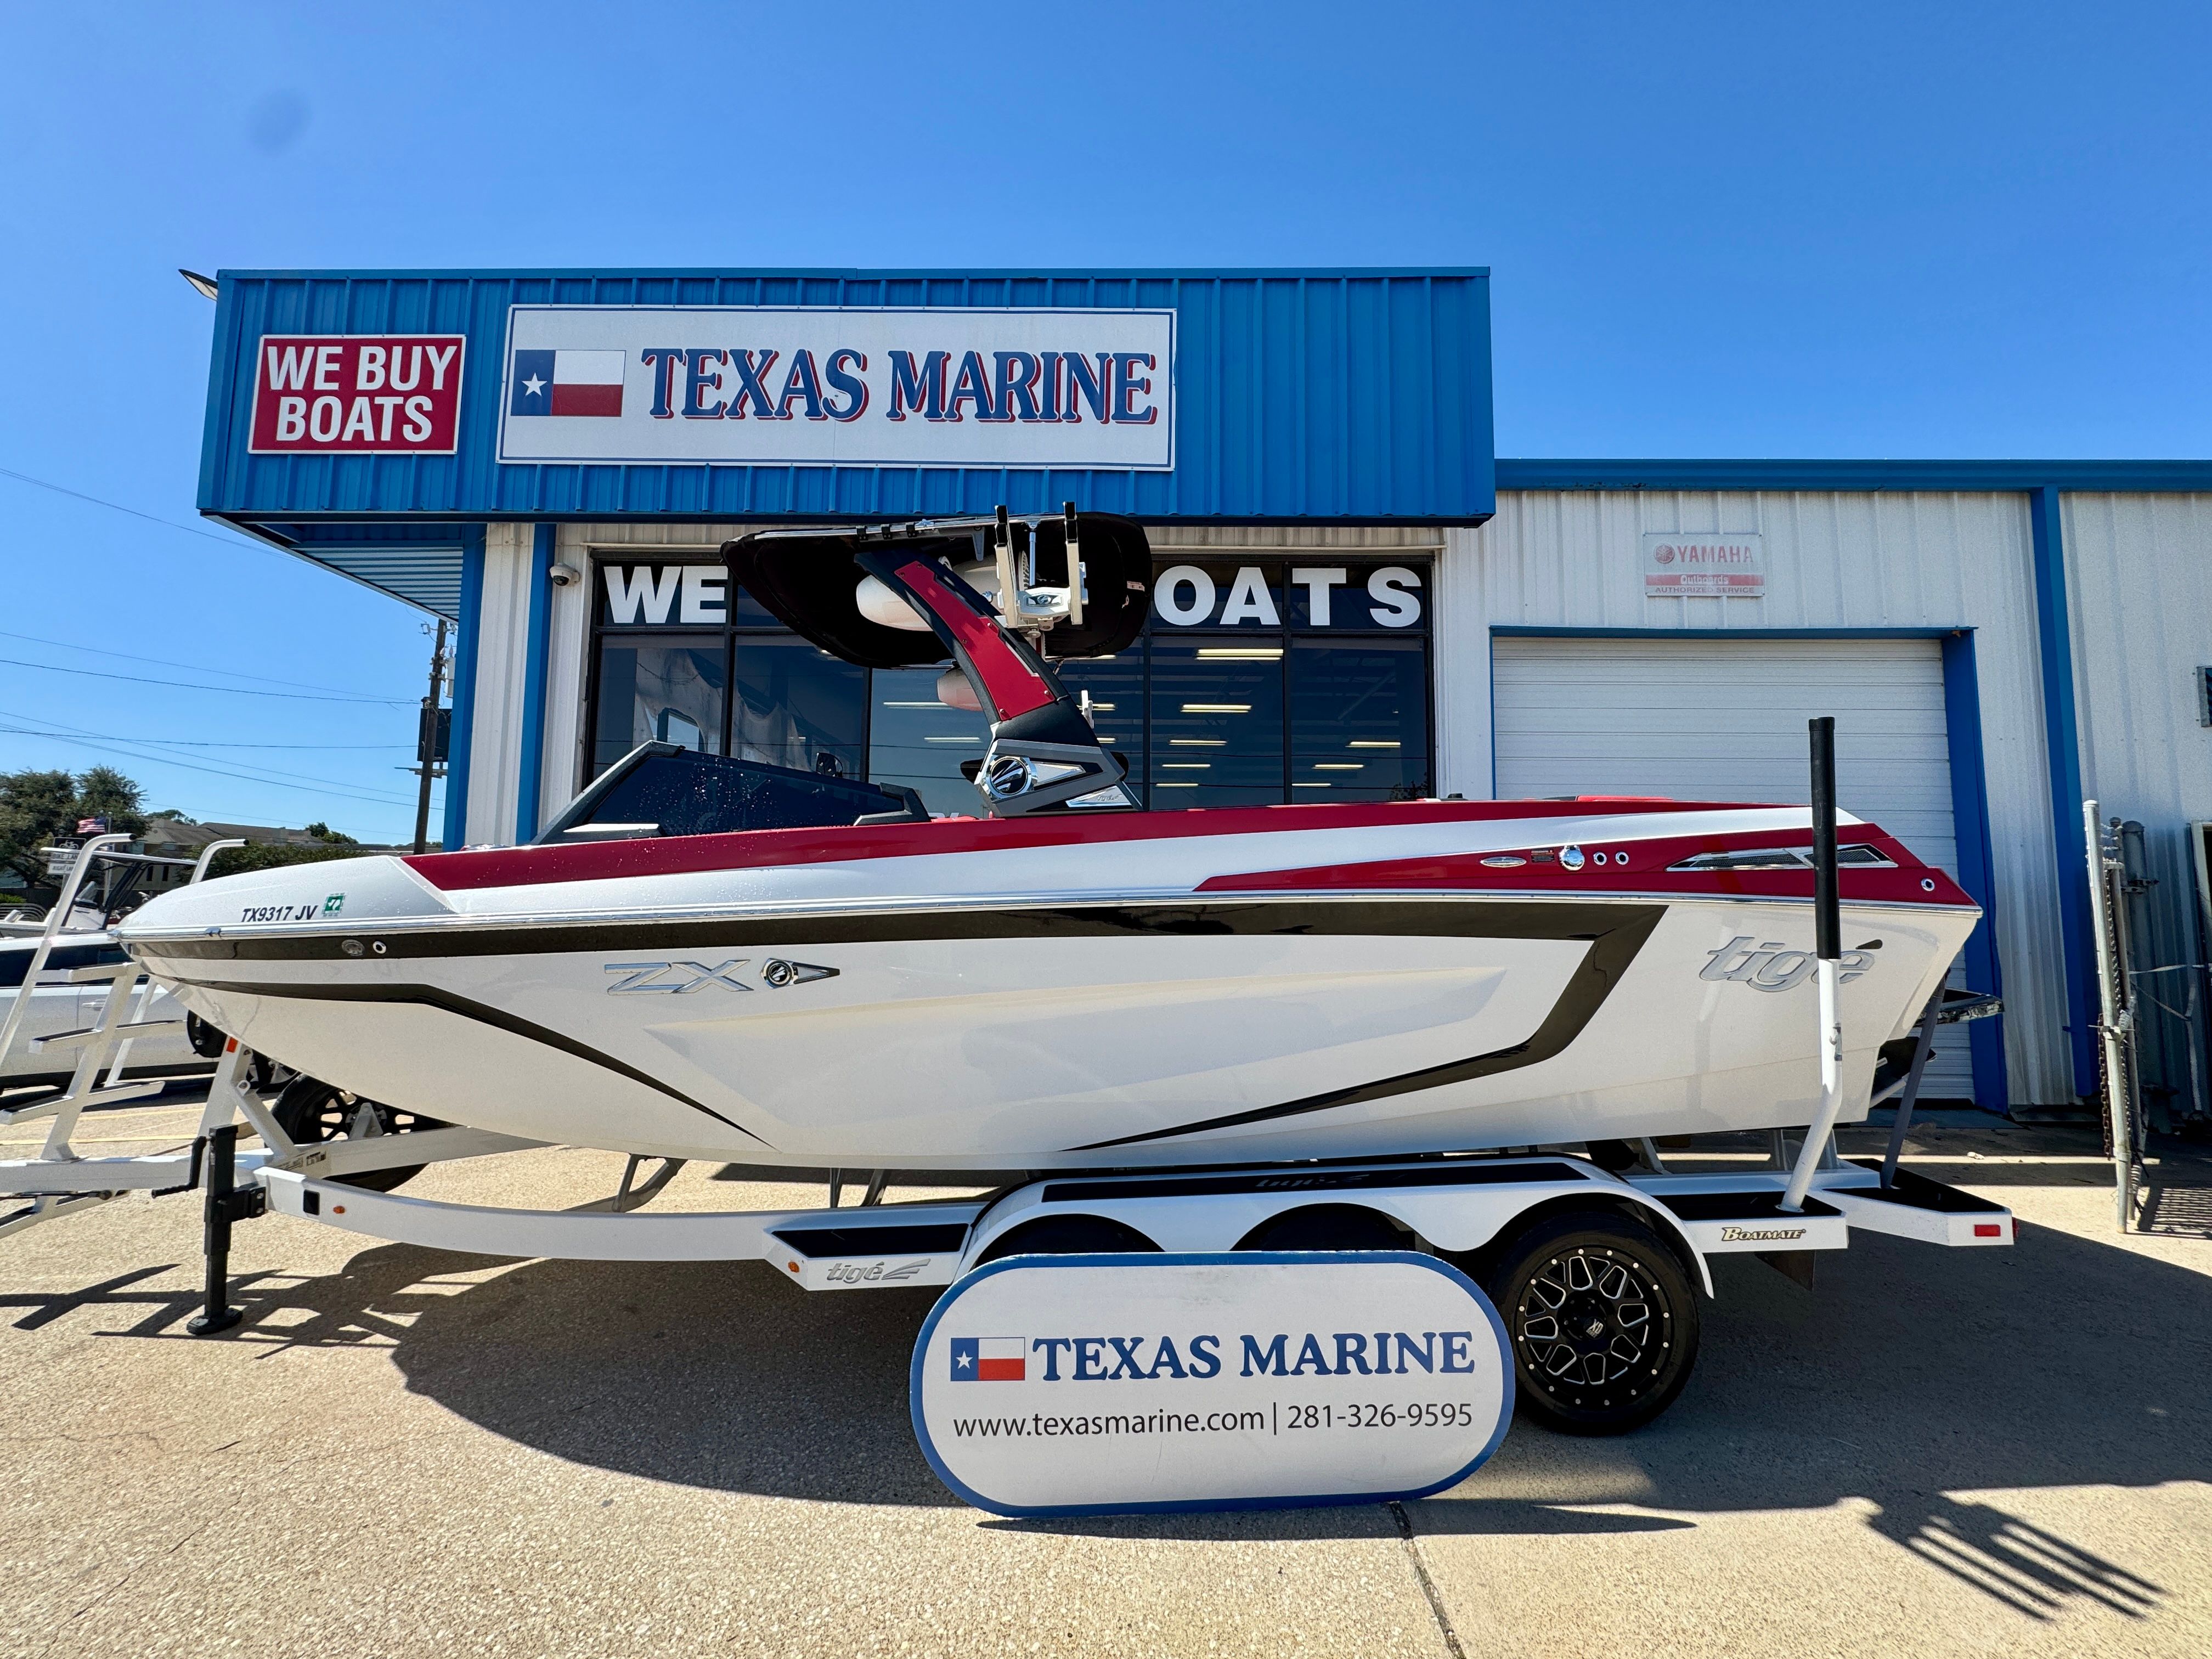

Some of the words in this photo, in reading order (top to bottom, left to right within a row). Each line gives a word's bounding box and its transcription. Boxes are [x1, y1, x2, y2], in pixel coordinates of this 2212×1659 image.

[267, 345, 344, 391] WE
[356, 345, 458, 391] BUY
[641, 348, 869, 423] TEXAS
[886, 350, 1158, 425] MARINE
[275, 396, 433, 442] BOATS
[1677, 545, 1754, 563] YAMAHA
[603, 566, 729, 623] WE
[1154, 565, 1422, 628] OATS
[1680, 574, 1729, 585] Outboards
[241, 906, 294, 923] TX9317
[295, 905, 318, 920] JV
[604, 959, 754, 995] ZX
[1722, 1227, 1803, 1242] BOATMATE
[826, 1261, 885, 1284] tigé
[1032, 1335, 1221, 1381] TEXAS
[1239, 1331, 1475, 1377] MARINE
[953, 1408, 1264, 1437] www.texasmarine.com
[1287, 1403, 1472, 1429] 281-326-9595
